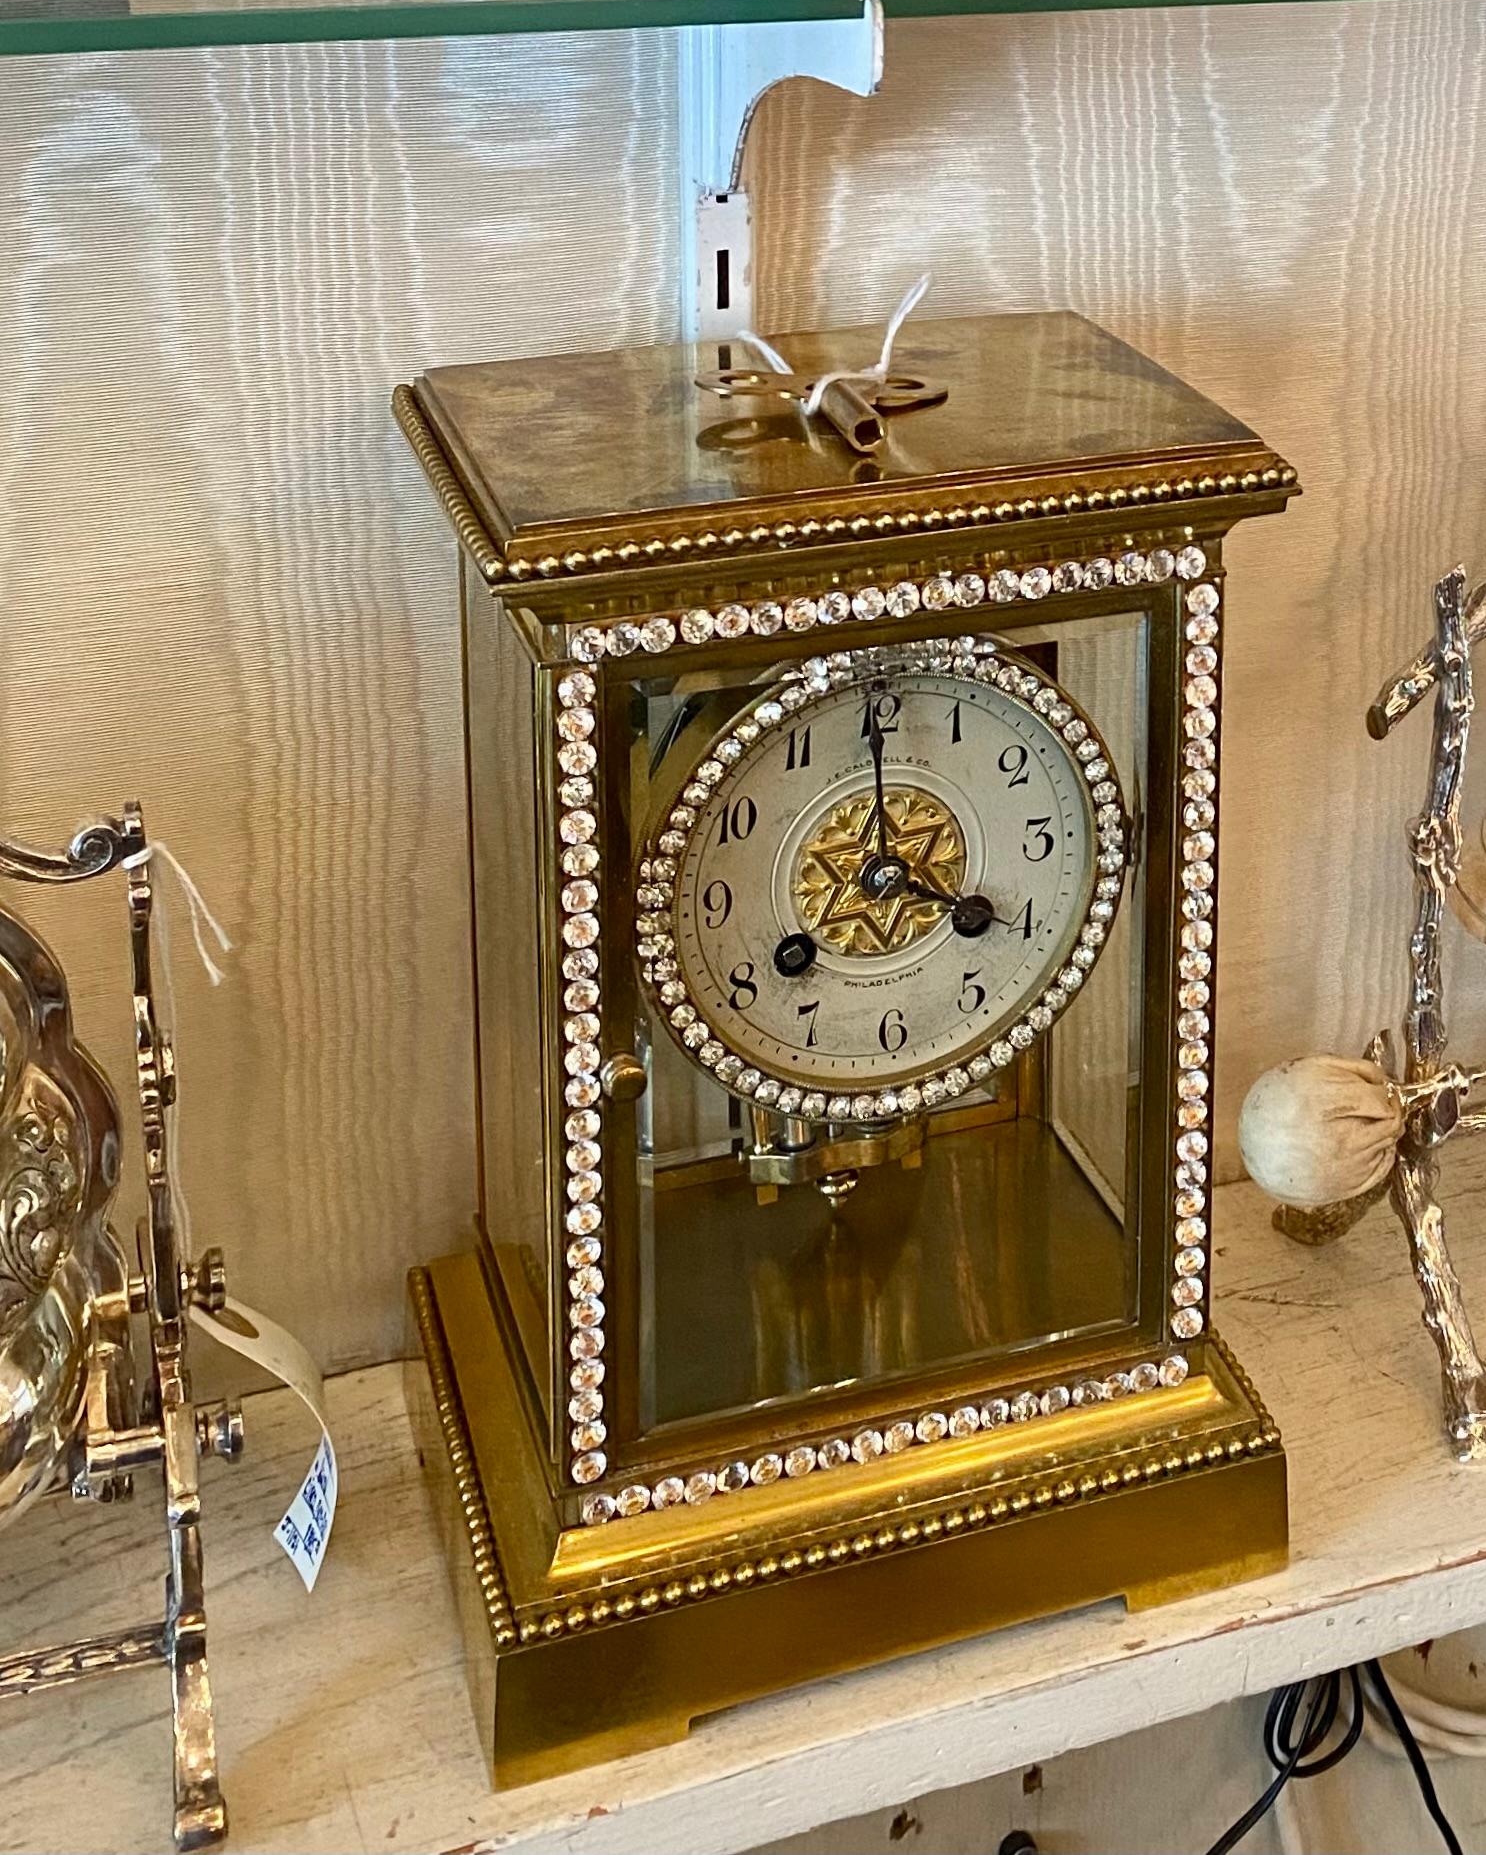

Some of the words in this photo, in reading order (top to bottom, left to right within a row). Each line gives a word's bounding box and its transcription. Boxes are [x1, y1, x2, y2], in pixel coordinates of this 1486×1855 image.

[856, 694, 902, 738] 12
[945, 699, 962, 744] 1
[783, 724, 811, 772] 11
[844, 756, 902, 773] CALDELL
[998, 744, 1030, 789] 2
[714, 796, 758, 847] 10
[1022, 816, 1054, 862] 3
[703, 879, 733, 930] 9
[1006, 897, 1043, 940] 4
[728, 961, 758, 1011] 8
[843, 967, 924, 988] PHILADELPHIA
[957, 967, 986, 1014] 5
[796, 1000, 820, 1048] 7
[878, 1008, 908, 1053] 6
